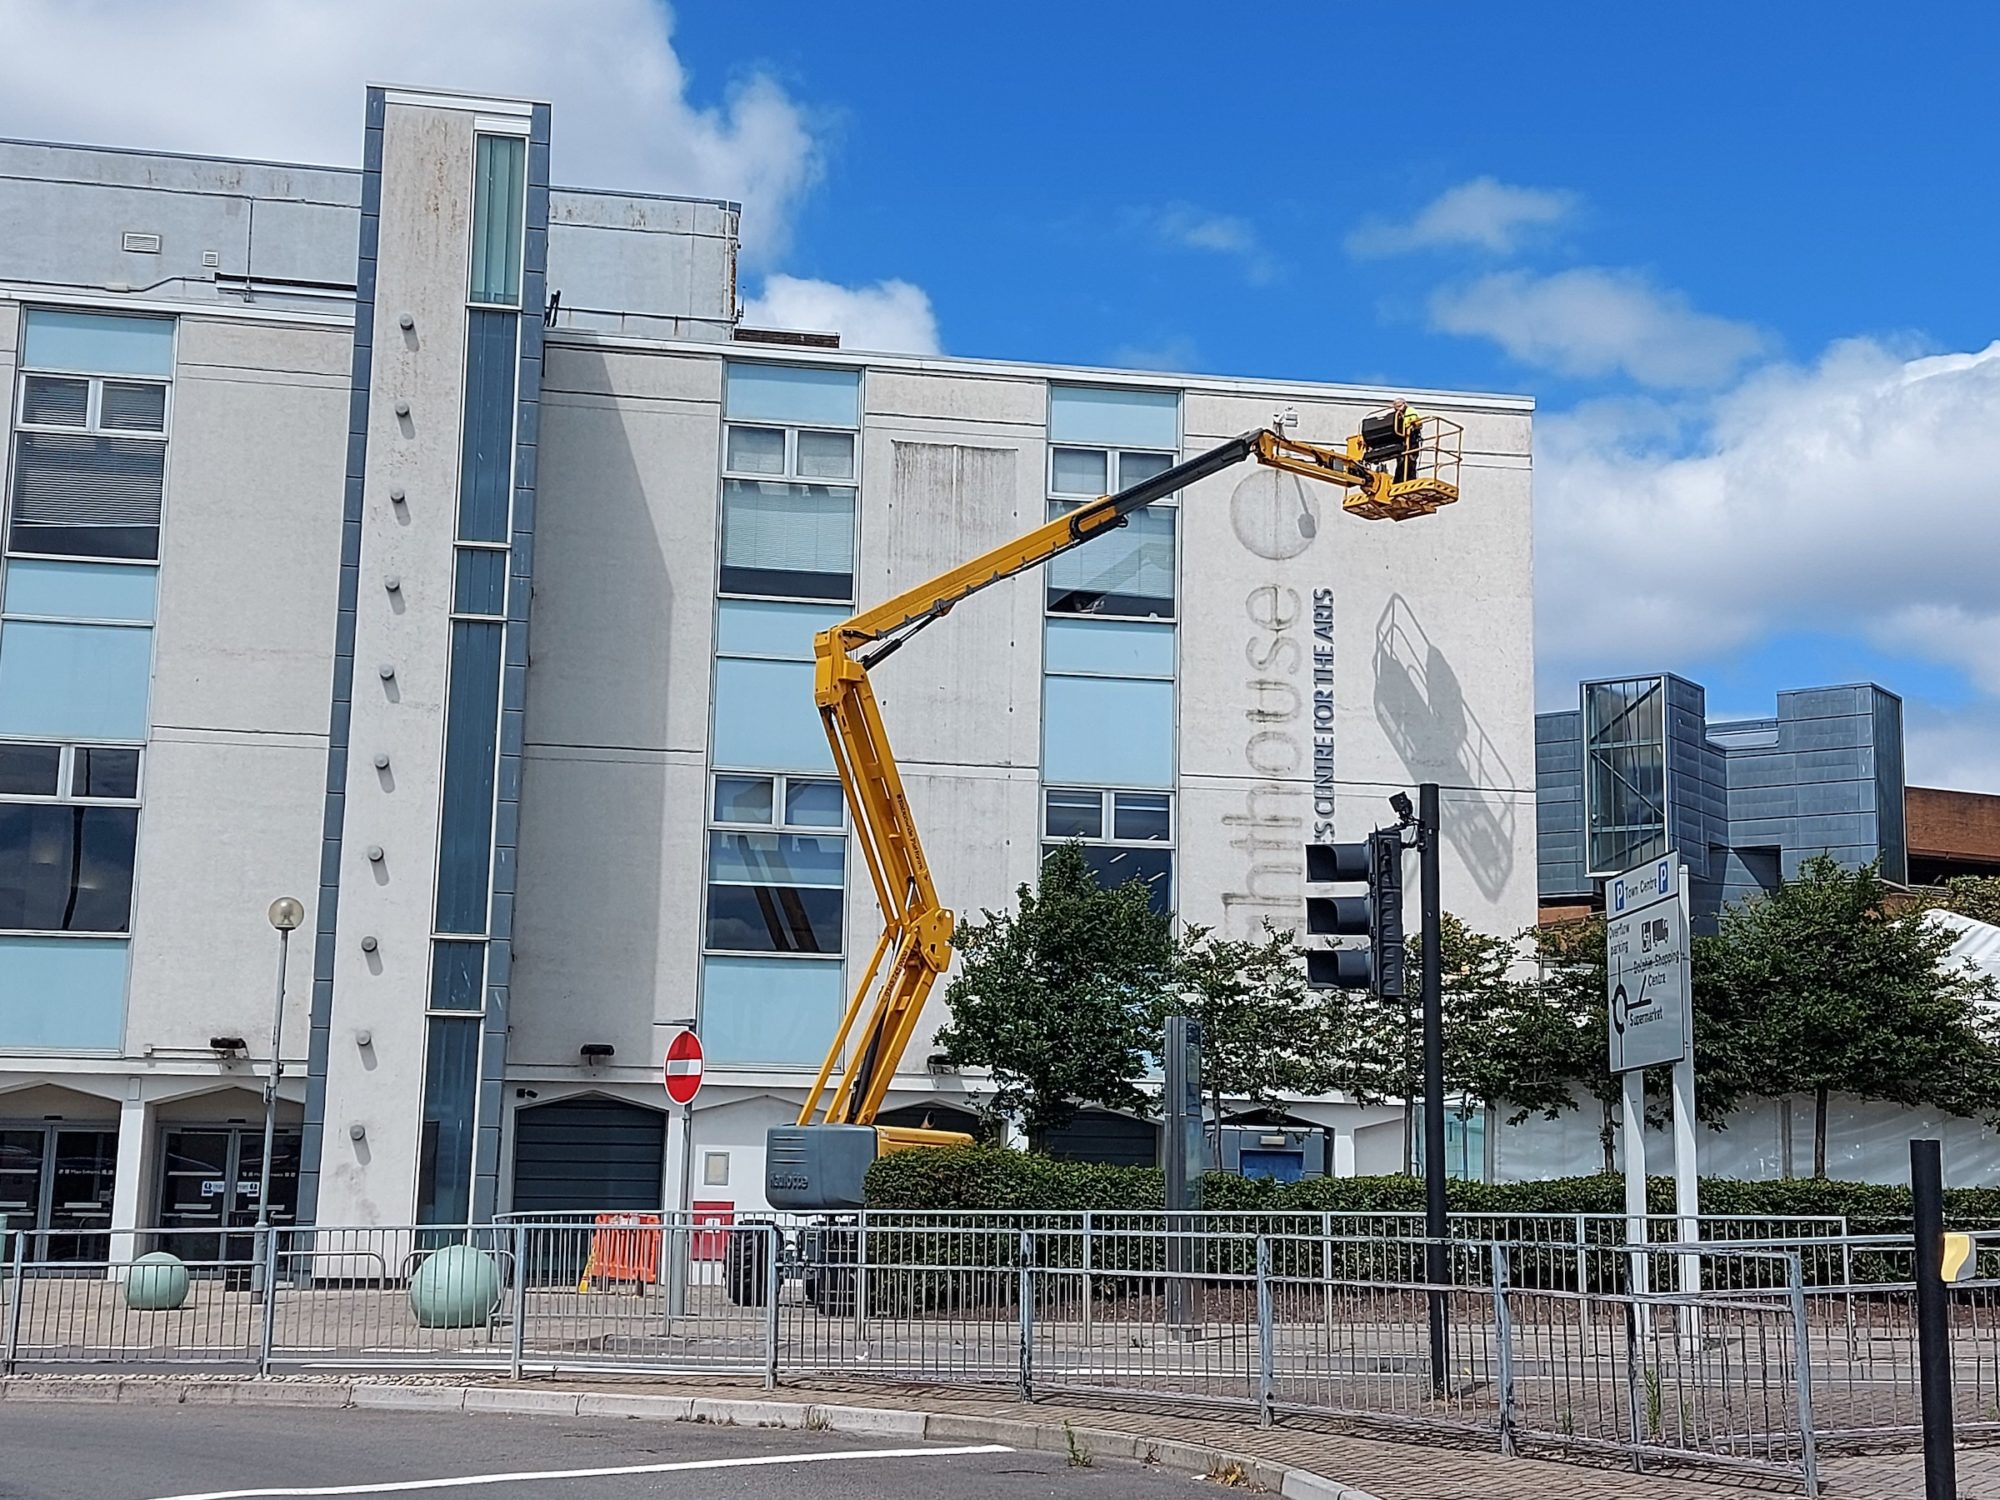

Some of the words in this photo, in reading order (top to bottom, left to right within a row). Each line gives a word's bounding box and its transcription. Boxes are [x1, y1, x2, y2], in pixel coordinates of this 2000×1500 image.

[1313, 588, 1334, 645] ARTS
[1313, 645, 1335, 688] THE
[1313, 689, 1335, 734] FOR
[1313, 736, 1335, 819] CENTRE
[1625, 885, 1639, 899] Town
[1640, 877, 1657, 894] Centre
[1609, 923, 1630, 940] Overflow
[1611, 941, 1629, 958] parking
[1655, 950, 1679, 967] Shopping
[1648, 972, 1666, 987] Centre
[1630, 1006, 1663, 1027] Supermarket
